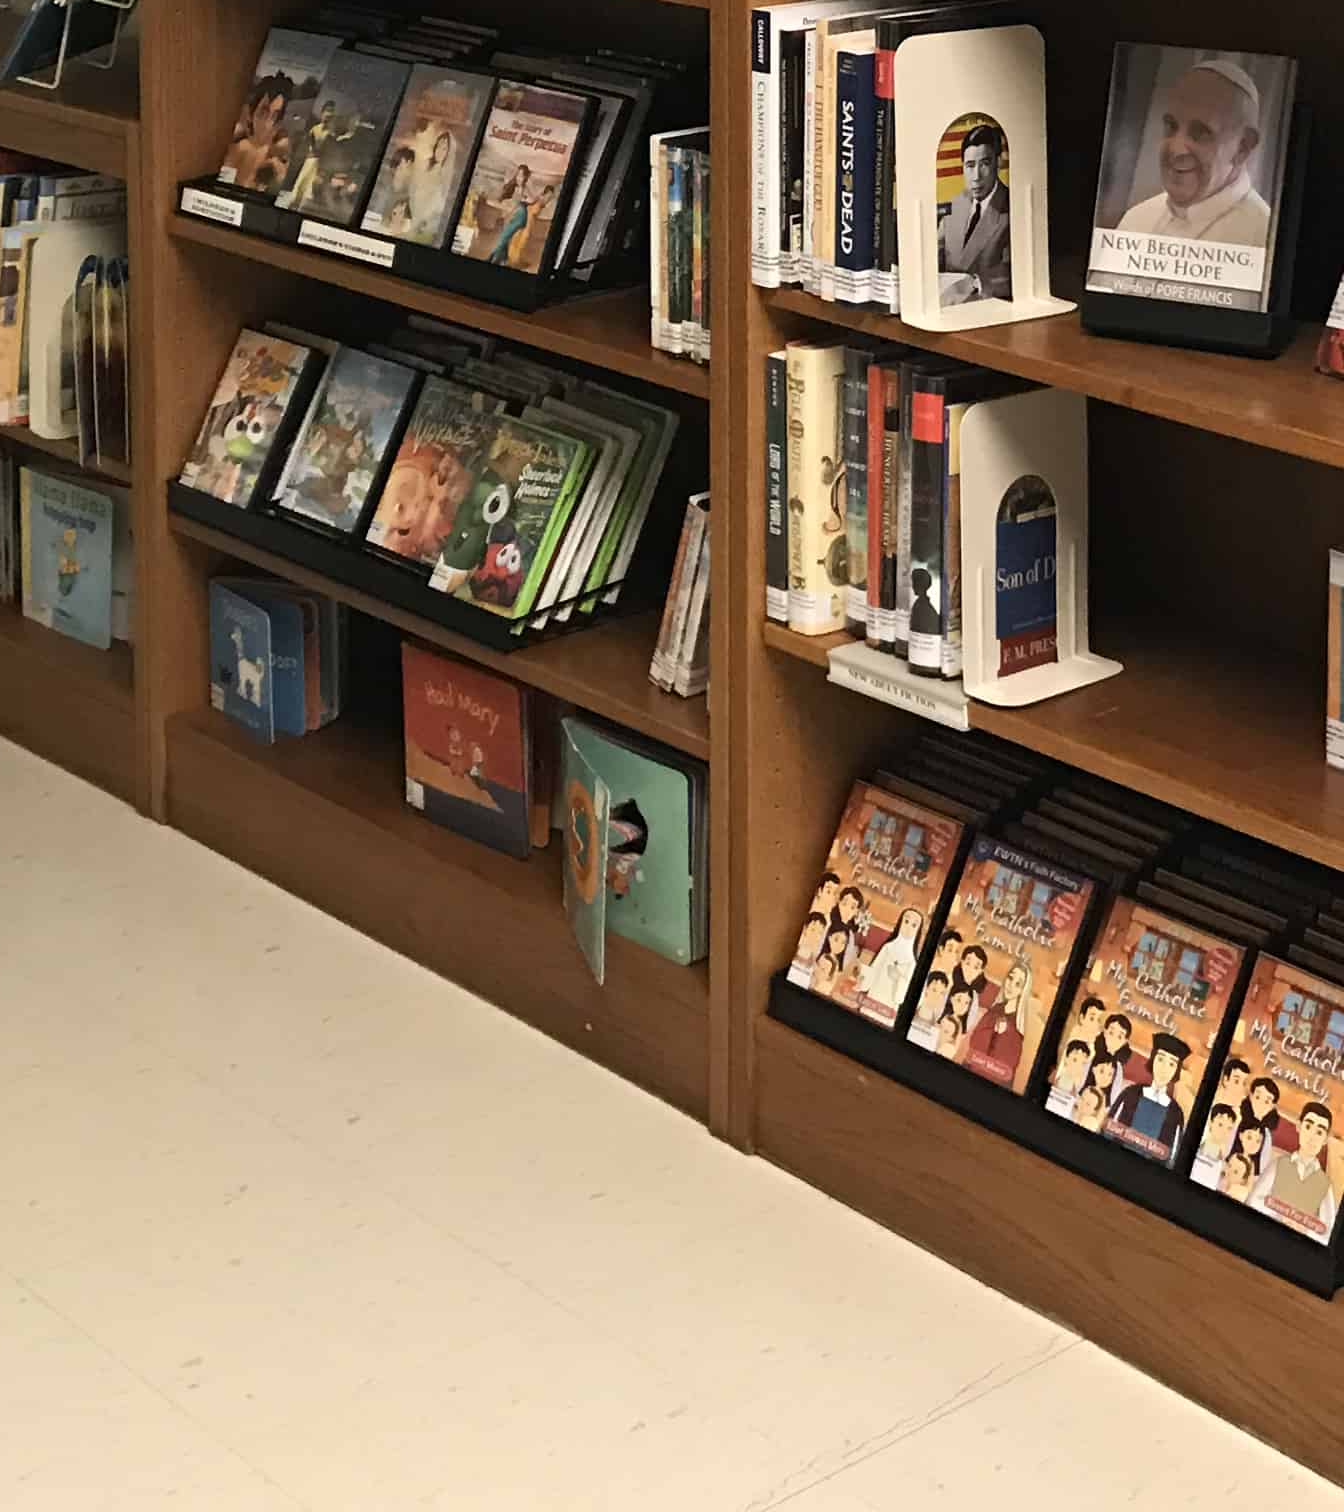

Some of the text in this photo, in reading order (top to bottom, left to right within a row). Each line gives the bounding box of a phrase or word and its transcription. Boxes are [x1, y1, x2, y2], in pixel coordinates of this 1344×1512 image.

[757, 19, 766, 65] CALLOWAY
[490, 124, 568, 155] Saint Perpetua
[756, 80, 767, 160] CHAMPIONS
[840, 101, 855, 254] SAINTS DEAD
[1100, 233, 1254, 268] NEW BEGINNING,
[1127, 255, 1222, 281] NEW HOPE
[1156, 283, 1233, 305] POPE FRANCIS
[768, 443, 781, 469] LORD
[768, 499, 781, 536] WORLD
[997, 567, 1023, 592] Son
[1026, 560, 1041, 586] of
[847, 667, 867, 683] NEW
[458, 692, 500, 737] Mary
[844, 838, 928, 888] My Catholic
[965, 893, 1057, 948] My Catholic
[974, 923, 1033, 964] Family
[1105, 959, 1209, 1020] My Catholic
[1117, 989, 1179, 1035] Family
[1249, 1021, 1273, 1053] My
[1263, 1050, 1330, 1103] Family
